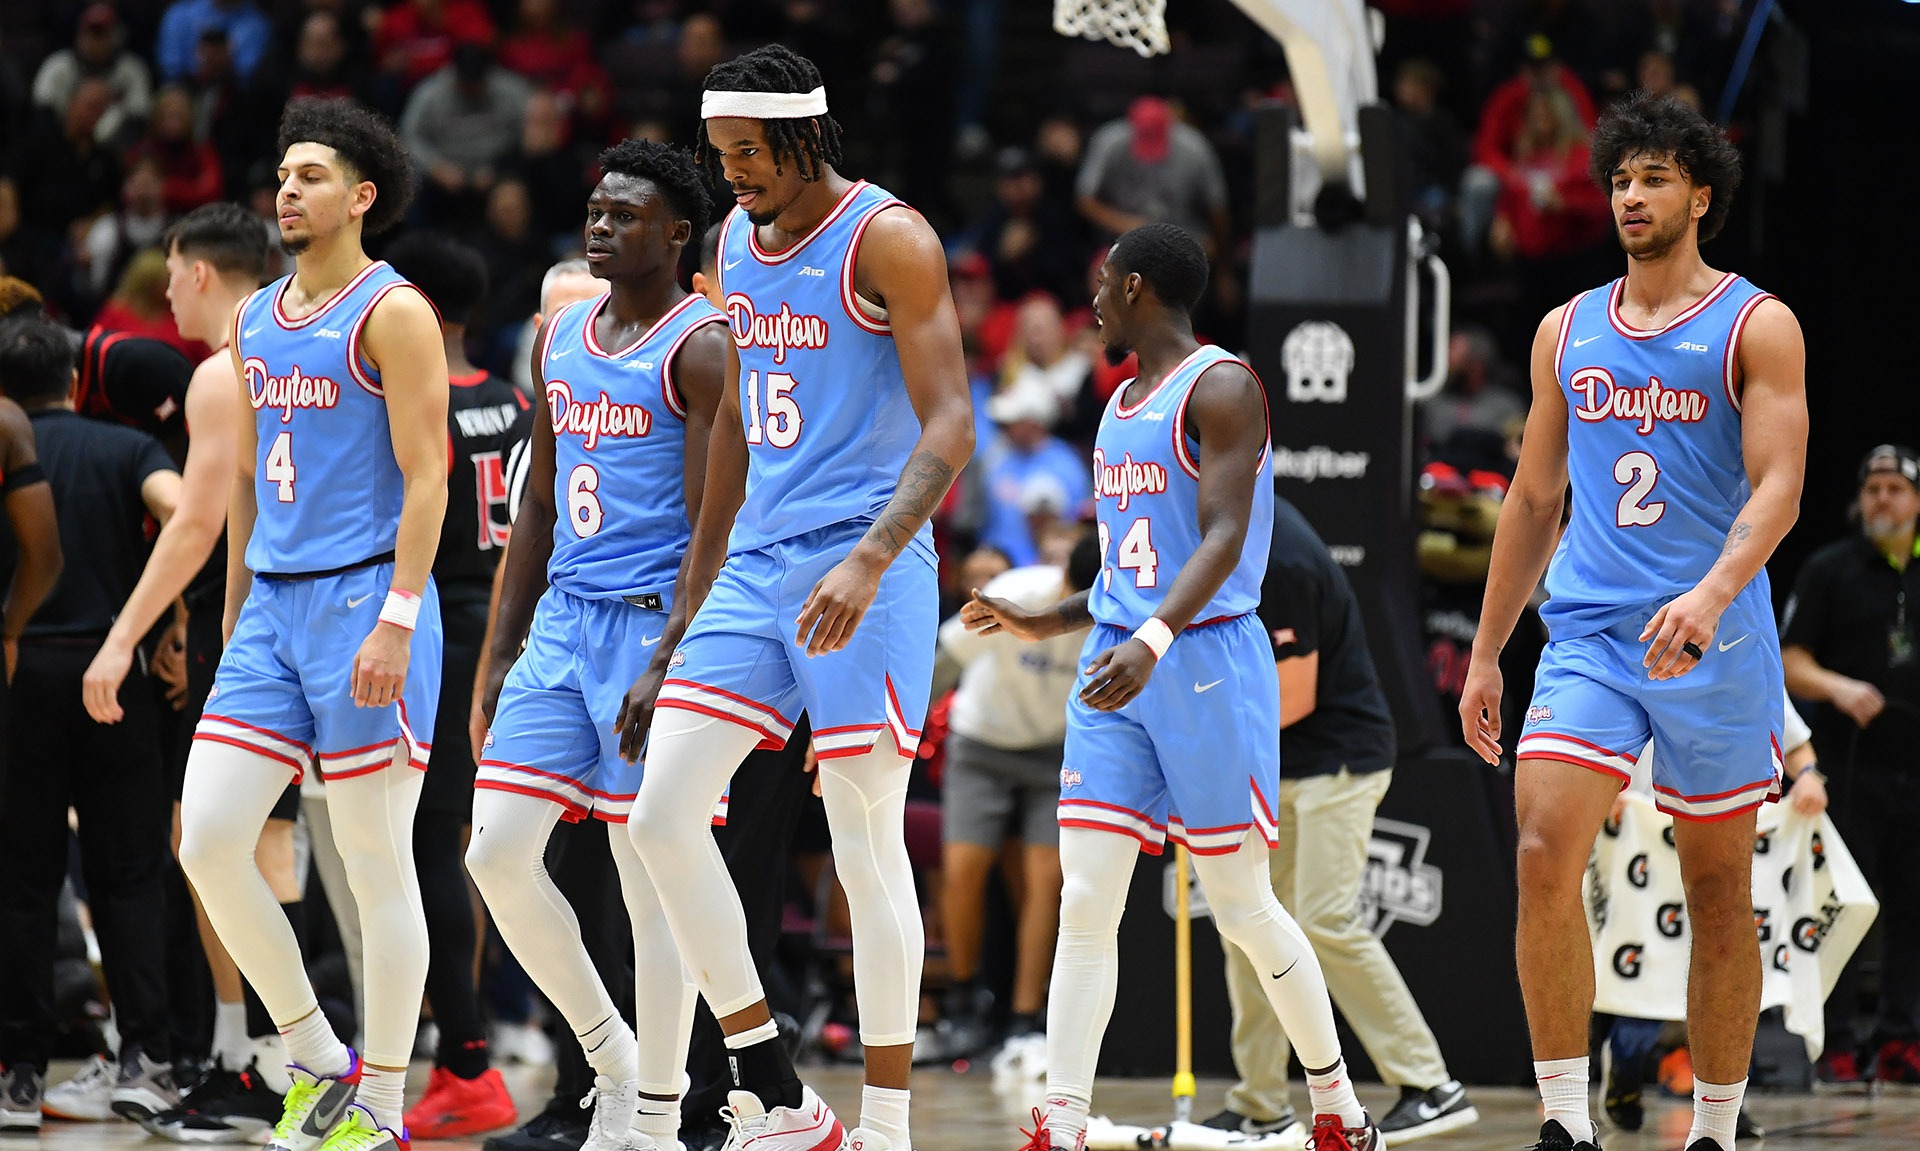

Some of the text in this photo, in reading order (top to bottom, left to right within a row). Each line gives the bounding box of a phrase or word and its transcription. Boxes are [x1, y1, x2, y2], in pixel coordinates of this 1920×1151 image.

[726, 291, 829, 366] Dayton
[243, 356, 340, 425] Dayton
[545, 379, 653, 452] Dayton
[747, 369, 804, 449] 15
[1569, 366, 1710, 437] Dayton
[264, 431, 297, 503] 4
[567, 463, 605, 539] 6
[1092, 447, 1167, 512] Dayton
[1612, 450, 1667, 528] 2
[648, 598, 657, 607] M
[1656, 902, 1684, 938] G
[1791, 916, 1820, 953] G
[1612, 943, 1644, 980] G
